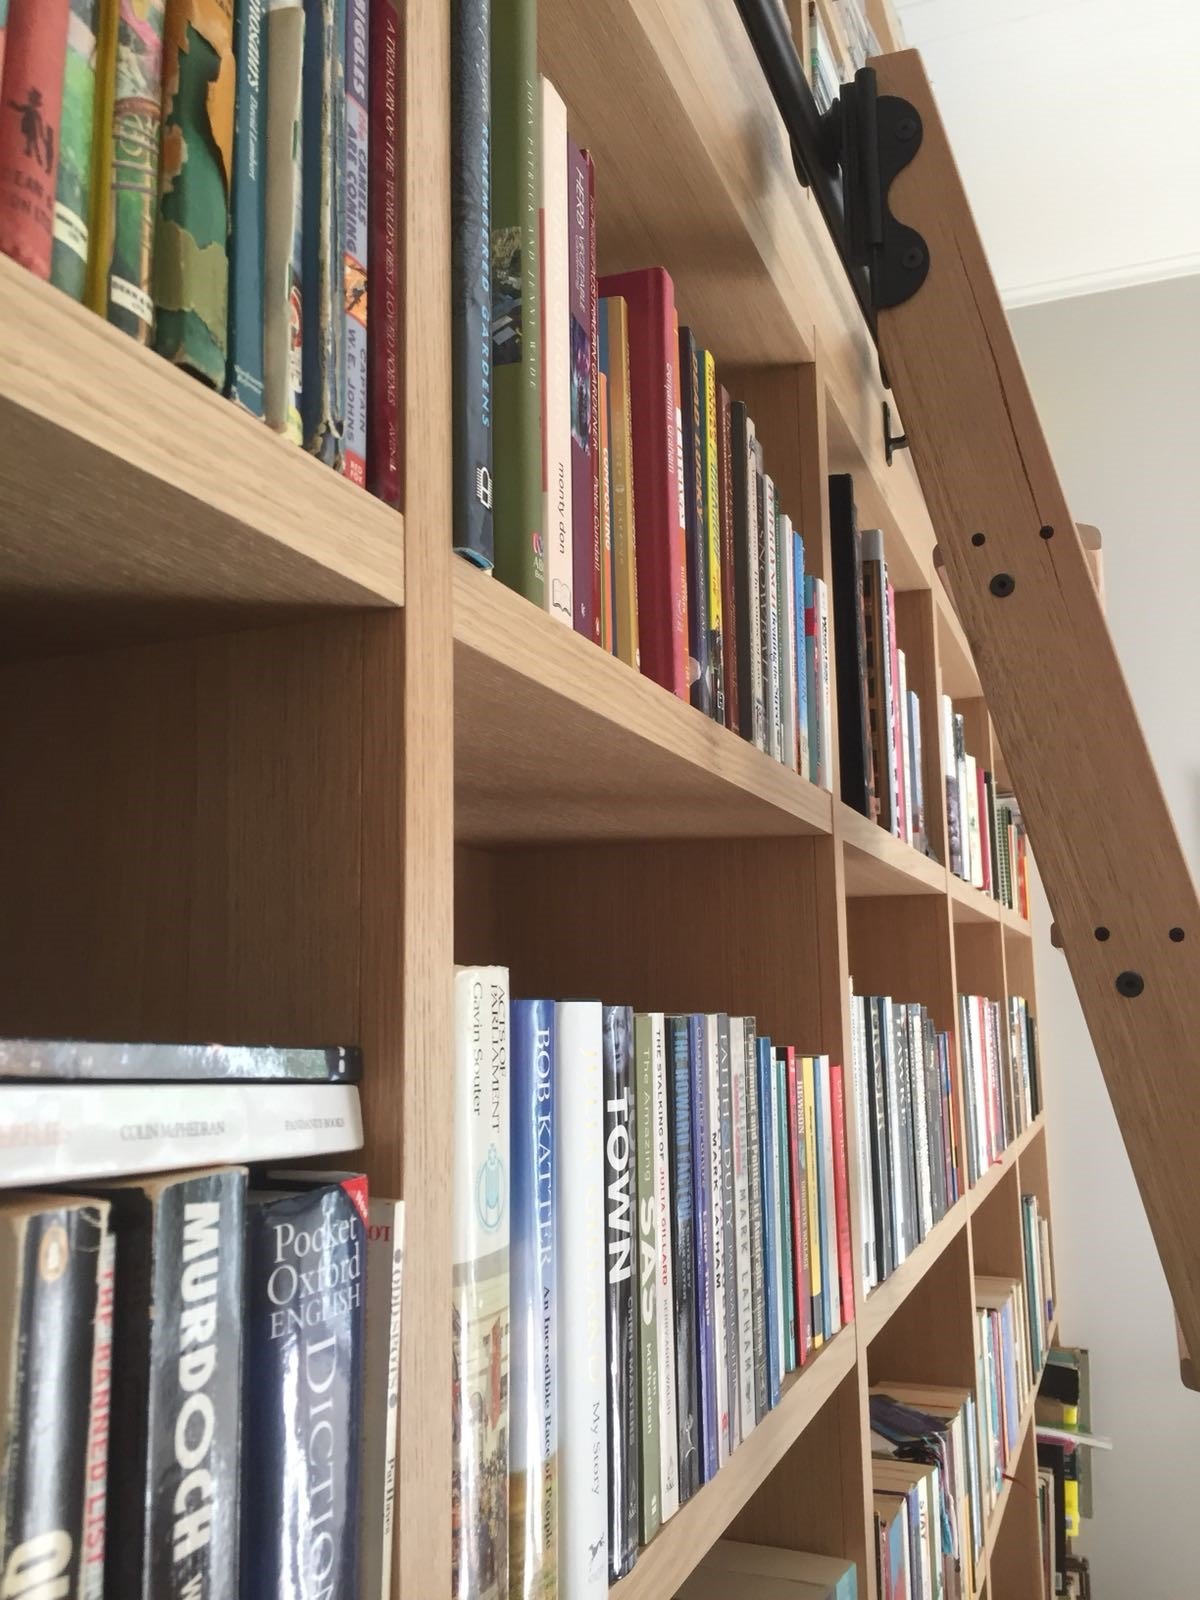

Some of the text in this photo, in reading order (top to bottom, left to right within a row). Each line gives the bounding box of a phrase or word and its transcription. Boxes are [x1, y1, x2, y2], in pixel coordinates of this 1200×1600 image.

[385, 19, 396, 33] A
[385, 35, 396, 116] TREASURY
[385, 116, 396, 138] OF
[385, 137, 396, 177] THE
[346, 123, 357, 254] ARE COMING
[357, 147, 367, 226] CAMELS
[481, 122, 490, 294] REMEMBERED
[385, 247, 395, 290] BEST
[526, 79, 537, 390] JOHN PATRICK AND JENNY WADE
[575, 166, 587, 313] HERB VEGETABLE
[385, 290, 396, 348] LOVED
[589, 263, 598, 361] AUSTRALIAN
[347, 328, 357, 442] W.E. JOHNS
[358, 348, 367, 433] CAPTAIN
[386, 348, 396, 408] POEMS
[481, 304, 491, 428] GARDENS
[590, 361, 599, 450] GARDENER
[663, 362, 676, 474] Benjamin Graham
[691, 351, 704, 525] DEAD LUCKY
[557, 461, 568, 555] monty don
[592, 474, 600, 515] Peter
[593, 515, 601, 571] Cundall
[757, 530, 768, 688] SNOWBALL
[472, 981, 484, 1116] Gavin Souter
[490, 984, 500, 1134] PARLIAMENT
[498, 986, 507, 1078] ACTS OF
[535, 1027, 551, 1103] BOB
[656, 1062, 665, 1138] STALKING
[721, 1034, 731, 1117] FAITH
[748, 1033, 758, 1112] Parliament
[797, 1079, 805, 1135] HEWSON
[119, 1122, 159, 1141] COLIN
[643, 1047, 653, 1183] The Amazing
[674, 1029, 691, 1221] THE HOWARD FACTOR
[751, 1114, 759, 1141] and
[536, 1112, 553, 1268] KATTER
[606, 1086, 633, 1285] TOWN
[659, 1168, 667, 1213] JULIA
[711, 1132, 719, 1192] MARK
[722, 1148, 734, 1229] DUTY
[752, 1143, 761, 1201] Politics
[267, 1241, 361, 1306] Oxford
[273, 1214, 358, 1264] Pocket
[639, 1195, 657, 1327] SAS
[660, 1217, 669, 1287] GILLARD
[714, 1202, 722, 1290] LATHAM
[754, 1220, 764, 1290] Australia
[269, 1283, 361, 1341] ENGLISH
[542, 1285, 551, 1308] An
[703, 1267, 711, 1327] Tingle
[740, 1188, 752, 1374] MARK LATHAM
[172, 1201, 221, 1564] MURDOCH
[543, 1317, 552, 1409] Incredible
[627, 1295, 637, 1447] CHRIS MASTERS
[645, 1341, 654, 1435] McPhedran
[90, 1342, 113, 1482] BANNED
[544, 1415, 553, 1459] Race
[590, 1400, 602, 1435] My
[590, 1441, 602, 1496] Story
[86, 1491, 107, 1565] LIST
[384, 1487, 396, 1536] Hayes
[543, 1486, 553, 1551] People
